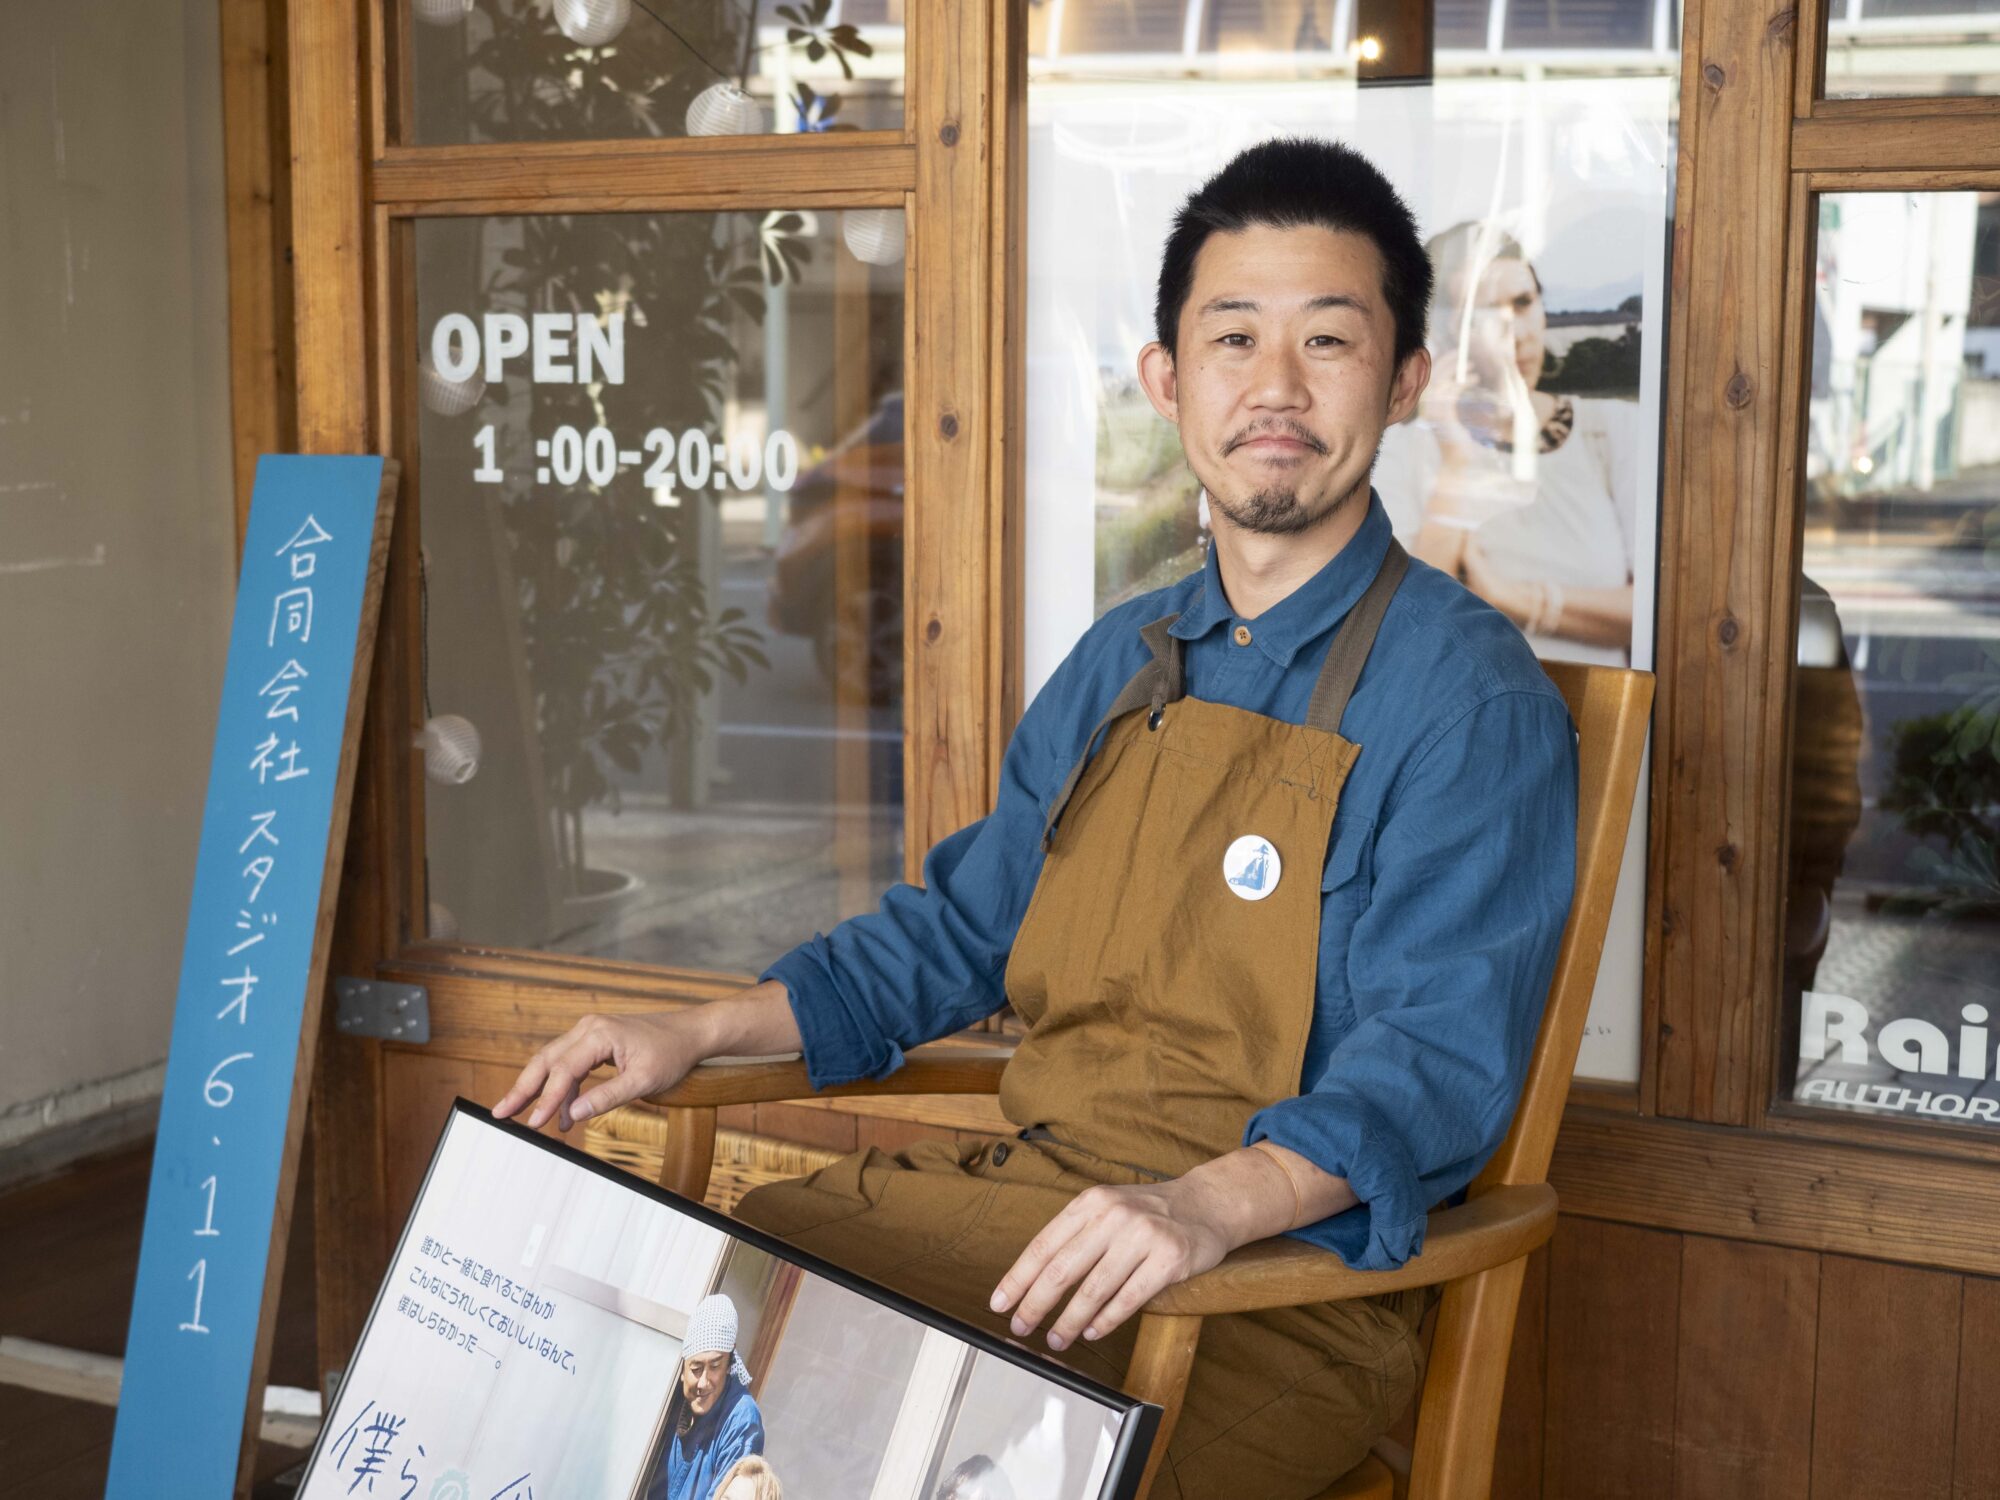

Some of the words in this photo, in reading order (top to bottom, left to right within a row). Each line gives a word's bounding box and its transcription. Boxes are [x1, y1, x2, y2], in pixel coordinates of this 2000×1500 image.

[431, 312, 626, 384] OPEN
[1799, 990, 2000, 1081] Rai
[409, 1265, 576, 1375] こんなにうれしくておいしいなんて、
[420, 1235, 557, 1320] 誰かと一緒に食べるごはんが
